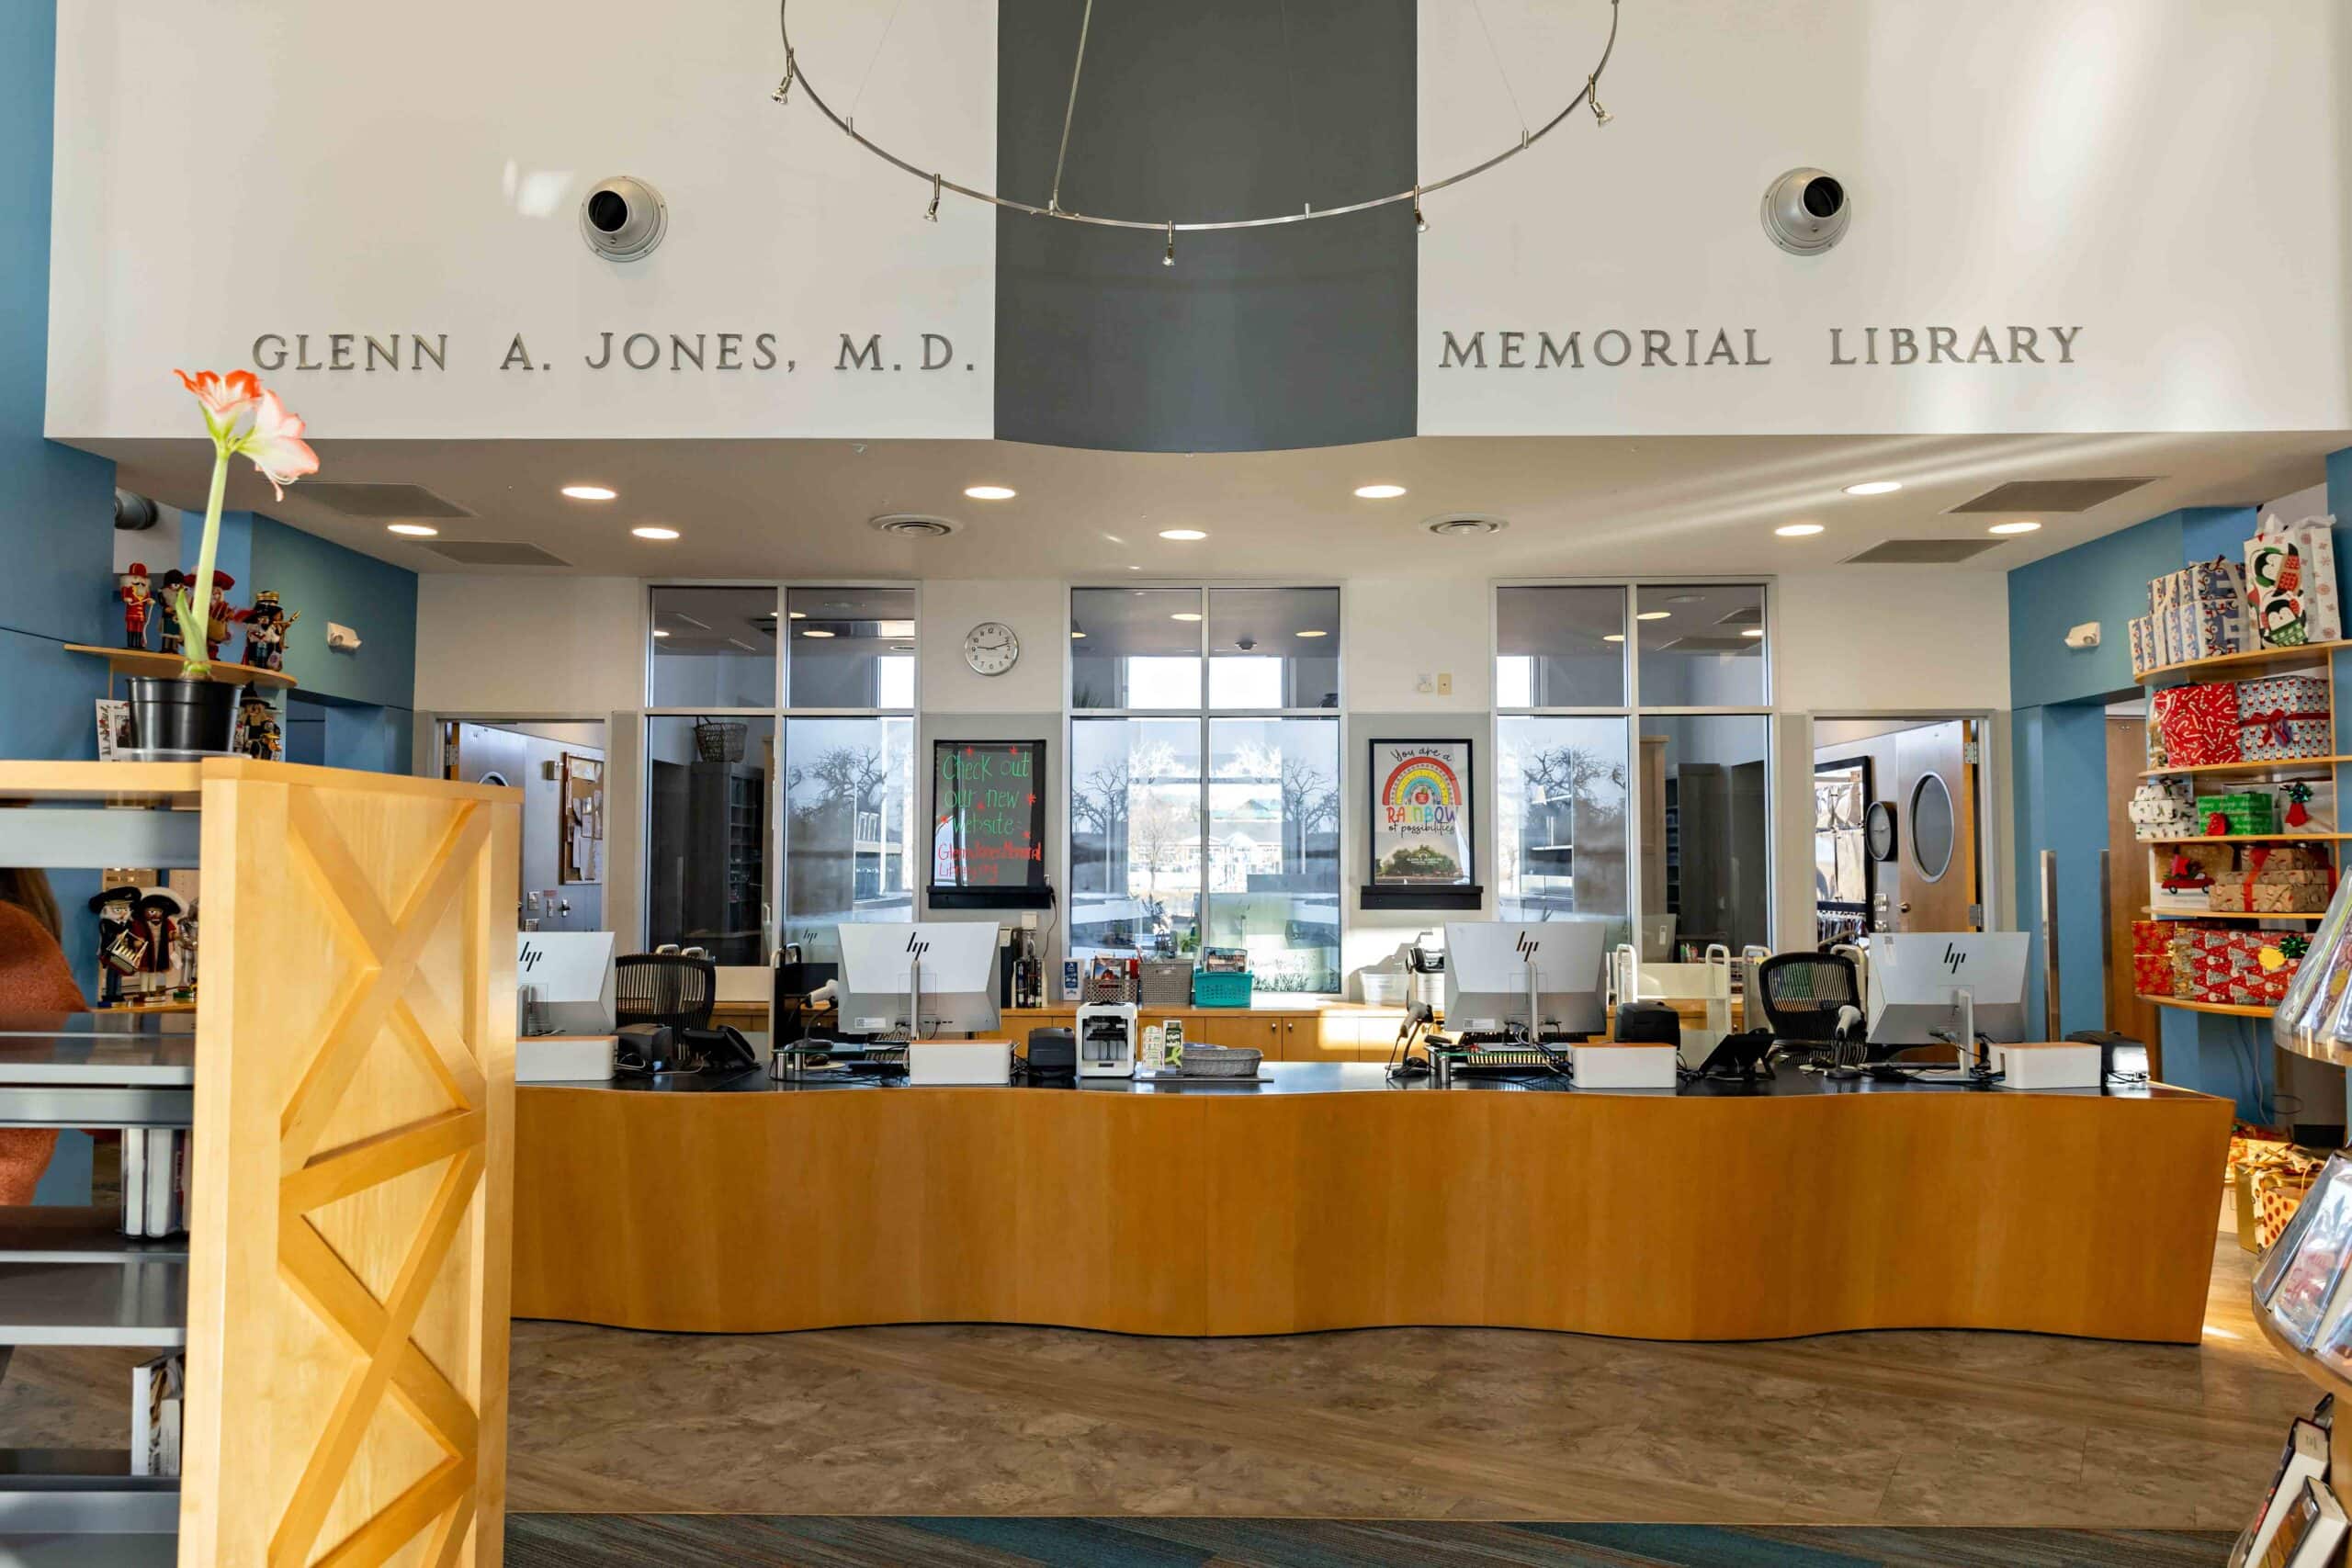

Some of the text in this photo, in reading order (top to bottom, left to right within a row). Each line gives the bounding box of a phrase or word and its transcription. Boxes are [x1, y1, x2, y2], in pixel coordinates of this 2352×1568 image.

[252, 333, 448, 371] GLENN
[499, 332, 551, 370] A.
[584, 332, 796, 372] JONES,
[1438, 327, 1772, 369] MEMORIAL
[1828, 325, 2084, 367] LIBRARY
[943, 750, 1030, 782] Check out
[1390, 749, 1415, 762] You
[1418, 747, 1441, 757] are
[944, 788, 1020, 809] our new
[1385, 806, 1458, 824] RAINBOW
[1388, 819, 1456, 838] of possibilities
[802, 929, 819, 944] hp
[906, 931, 930, 961] hp
[1516, 931, 1540, 963] hp
[519, 941, 543, 972] hp
[1943, 942, 1967, 975] hp
